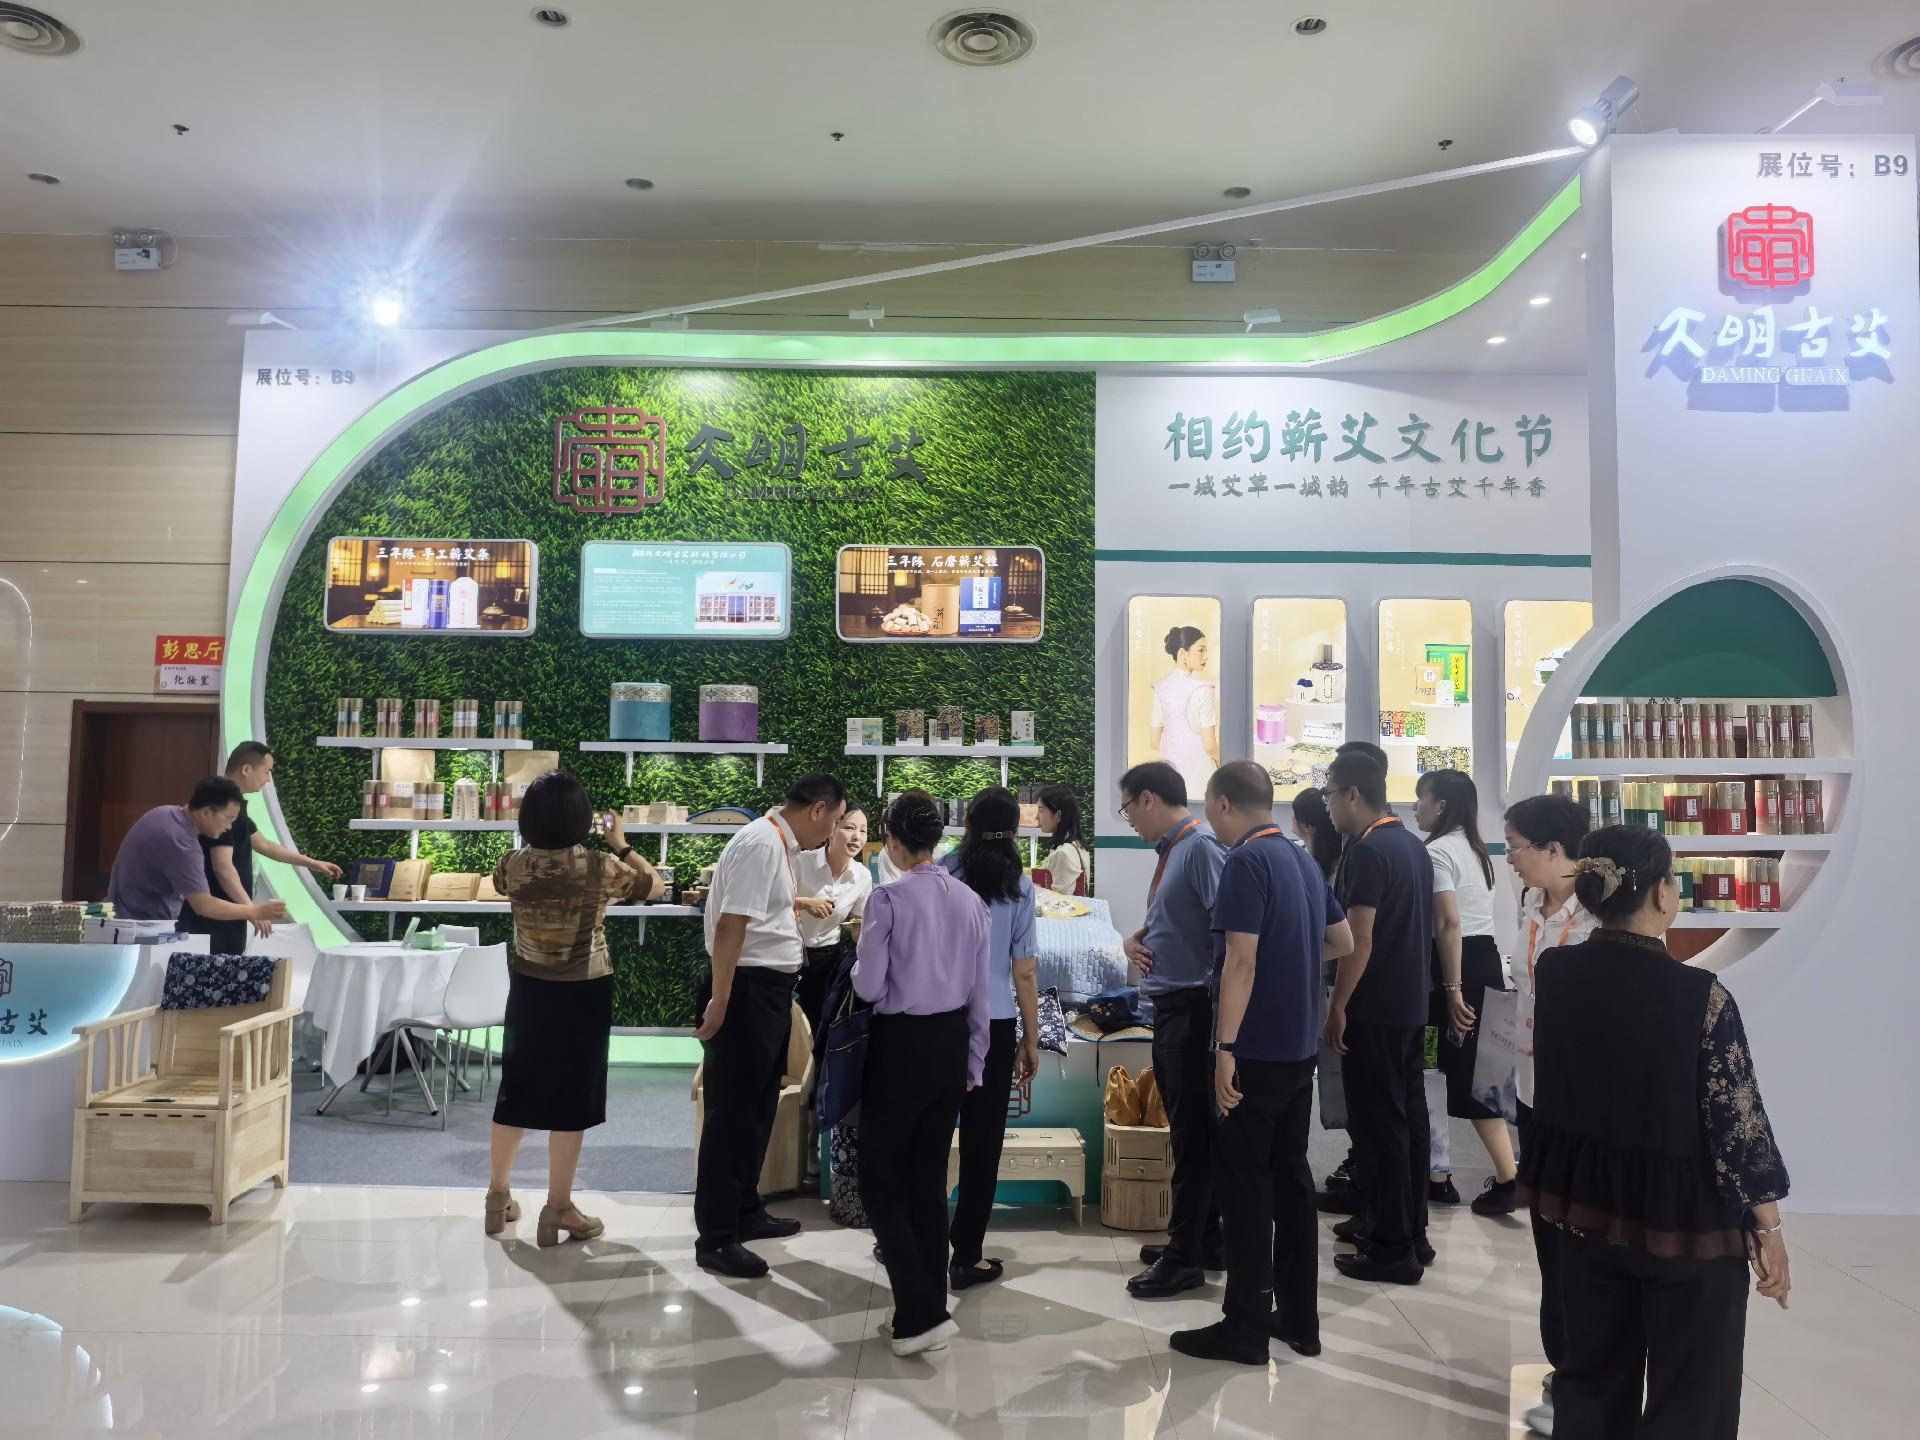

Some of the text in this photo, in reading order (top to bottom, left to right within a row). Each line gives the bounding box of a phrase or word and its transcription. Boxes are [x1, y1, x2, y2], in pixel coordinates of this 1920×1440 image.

[1757, 152, 1909, 178] 展位号： B9
[255, 368, 356, 386] 展位号： B9
[1701, 366, 1781, 384] DAMING
[1164, 407, 1553, 469] 相约蕲艾文化节
[1367, 474, 1548, 499] 千年古艾千年香
